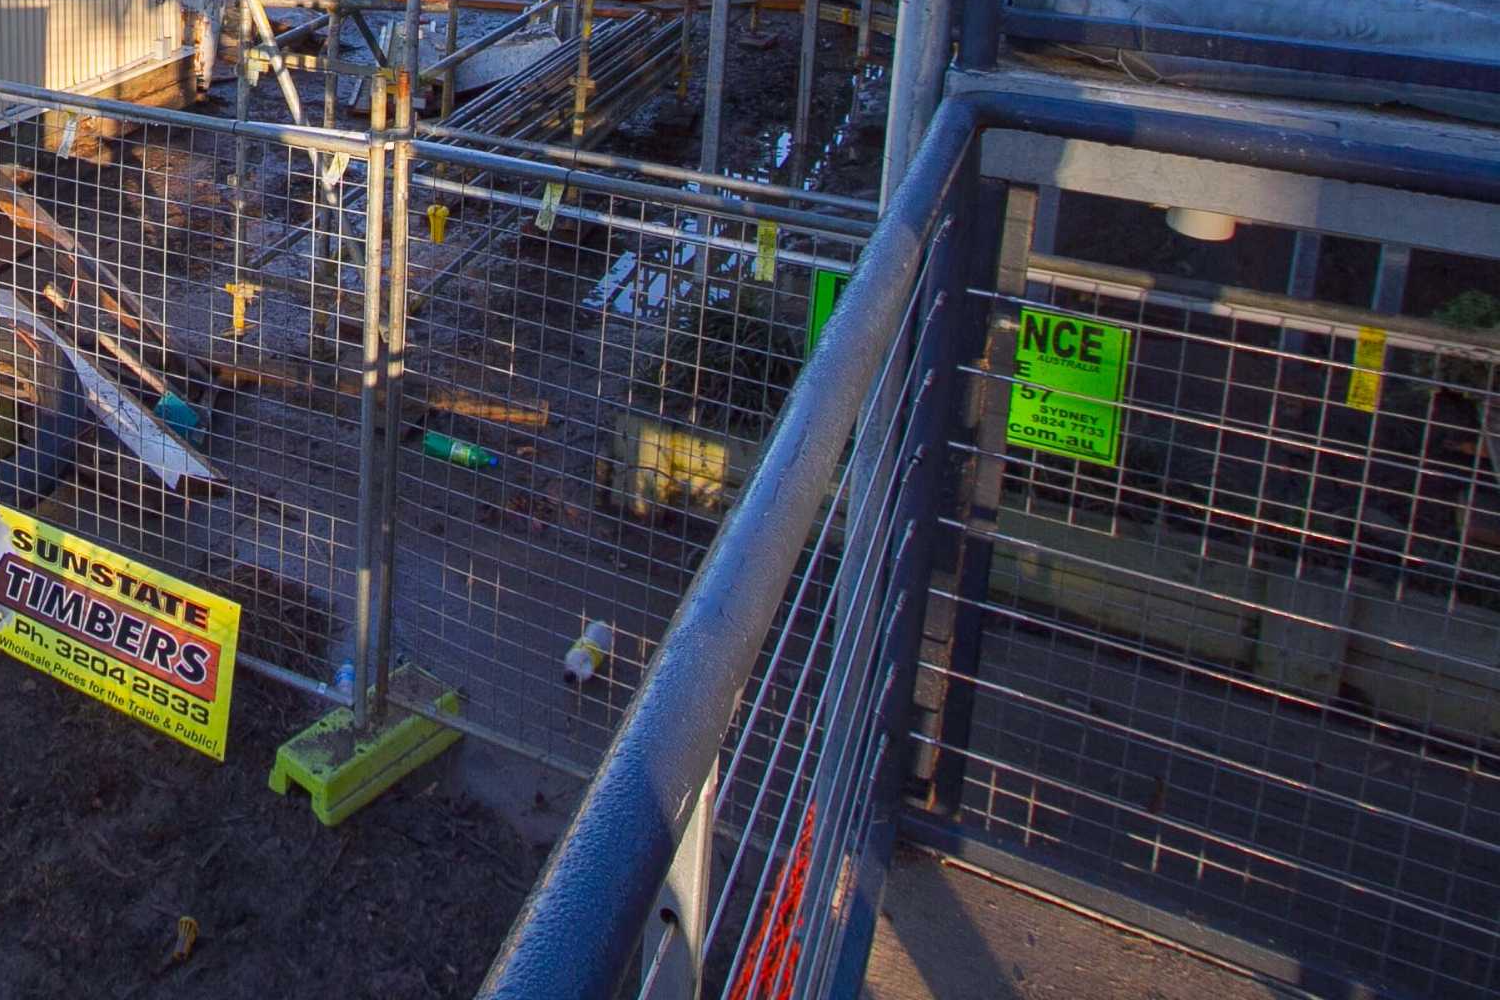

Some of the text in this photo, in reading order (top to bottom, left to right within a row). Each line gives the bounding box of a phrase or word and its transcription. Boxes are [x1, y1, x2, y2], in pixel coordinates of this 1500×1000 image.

[1023, 314, 1105, 364] NCE
[1037, 355, 1101, 374] AUSTRALIA
[1031, 414, 1105, 438] 9824 7733
[1039, 405, 1100, 425] SYDNEY
[11, 528, 211, 632] SUNSTATE
[5, 562, 212, 686] TIMBERS
[0, 634, 219, 752] Wholesale Prices for the Trade & Public!
[14, 618, 210, 726] Ph. 3204 2533
